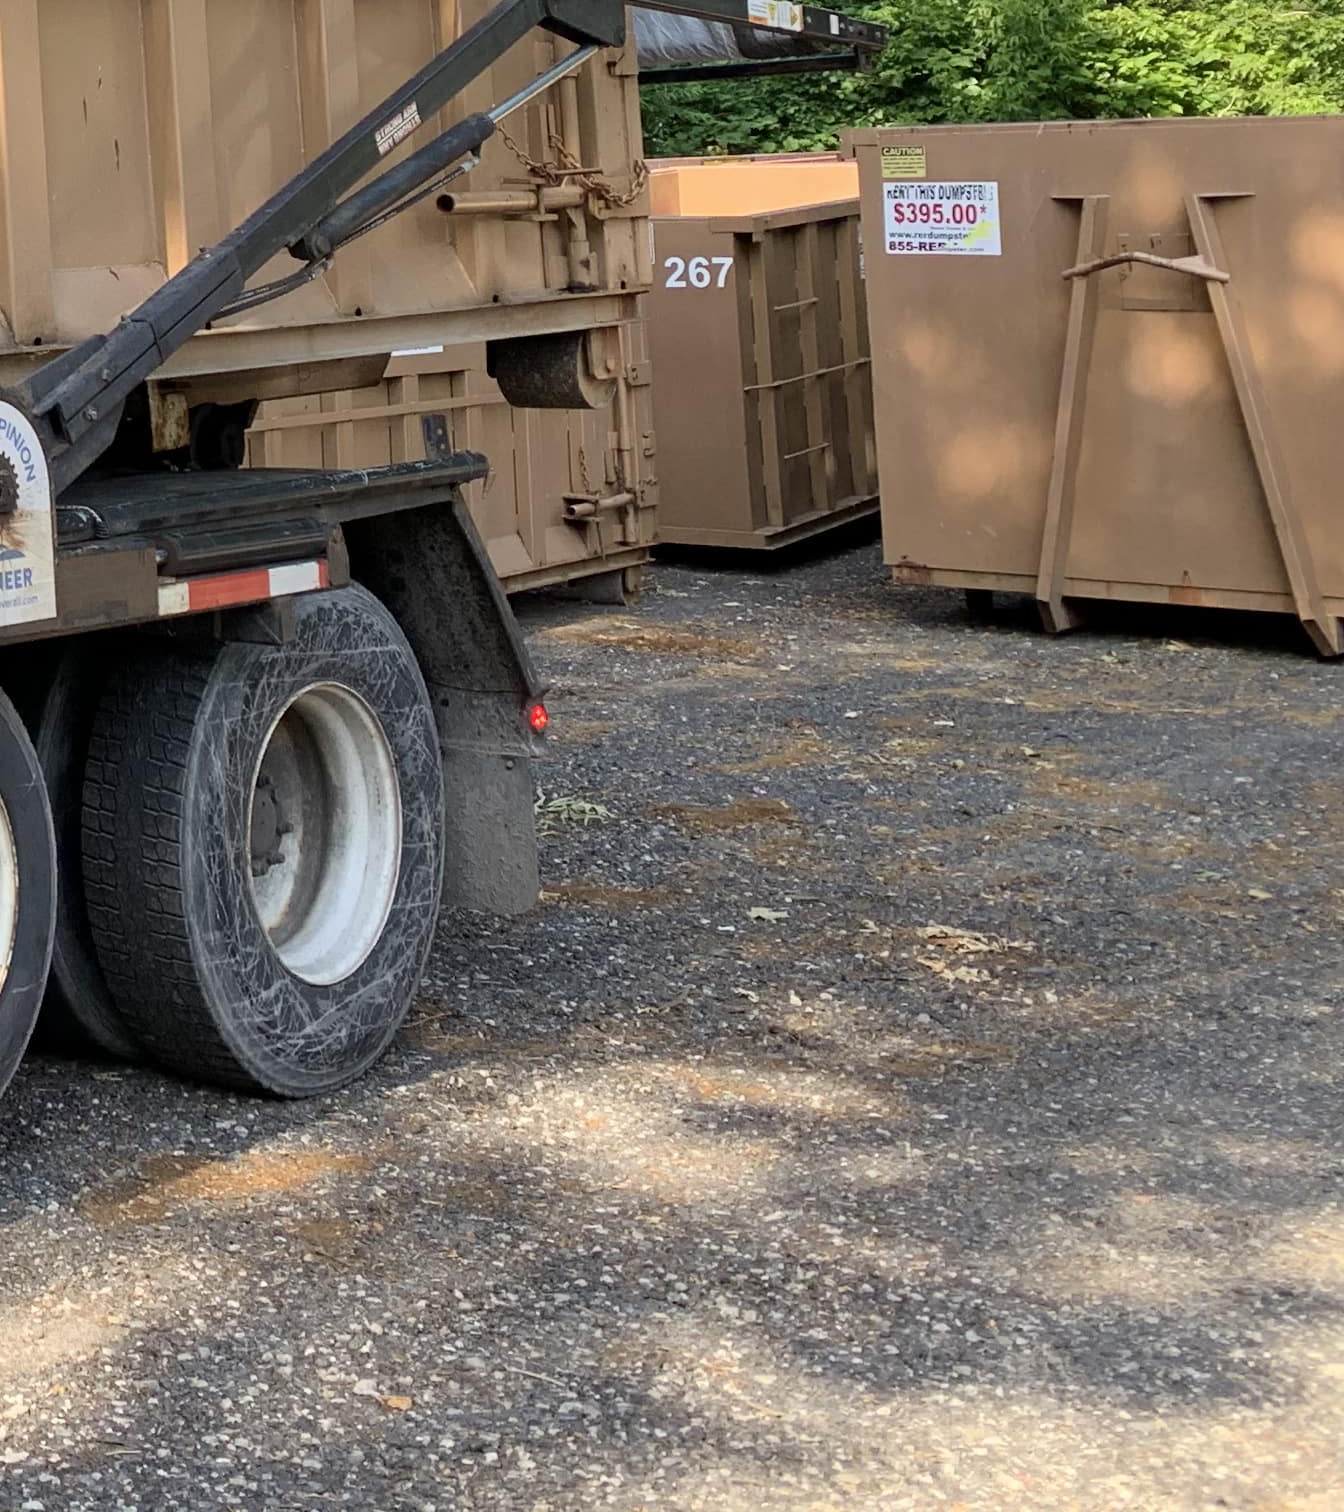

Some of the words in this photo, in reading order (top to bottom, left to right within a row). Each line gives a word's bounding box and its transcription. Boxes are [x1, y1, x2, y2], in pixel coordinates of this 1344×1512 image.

[883, 146, 924, 156] CAUTION
[914, 184, 936, 200] THIS
[664, 256, 734, 288] 267
